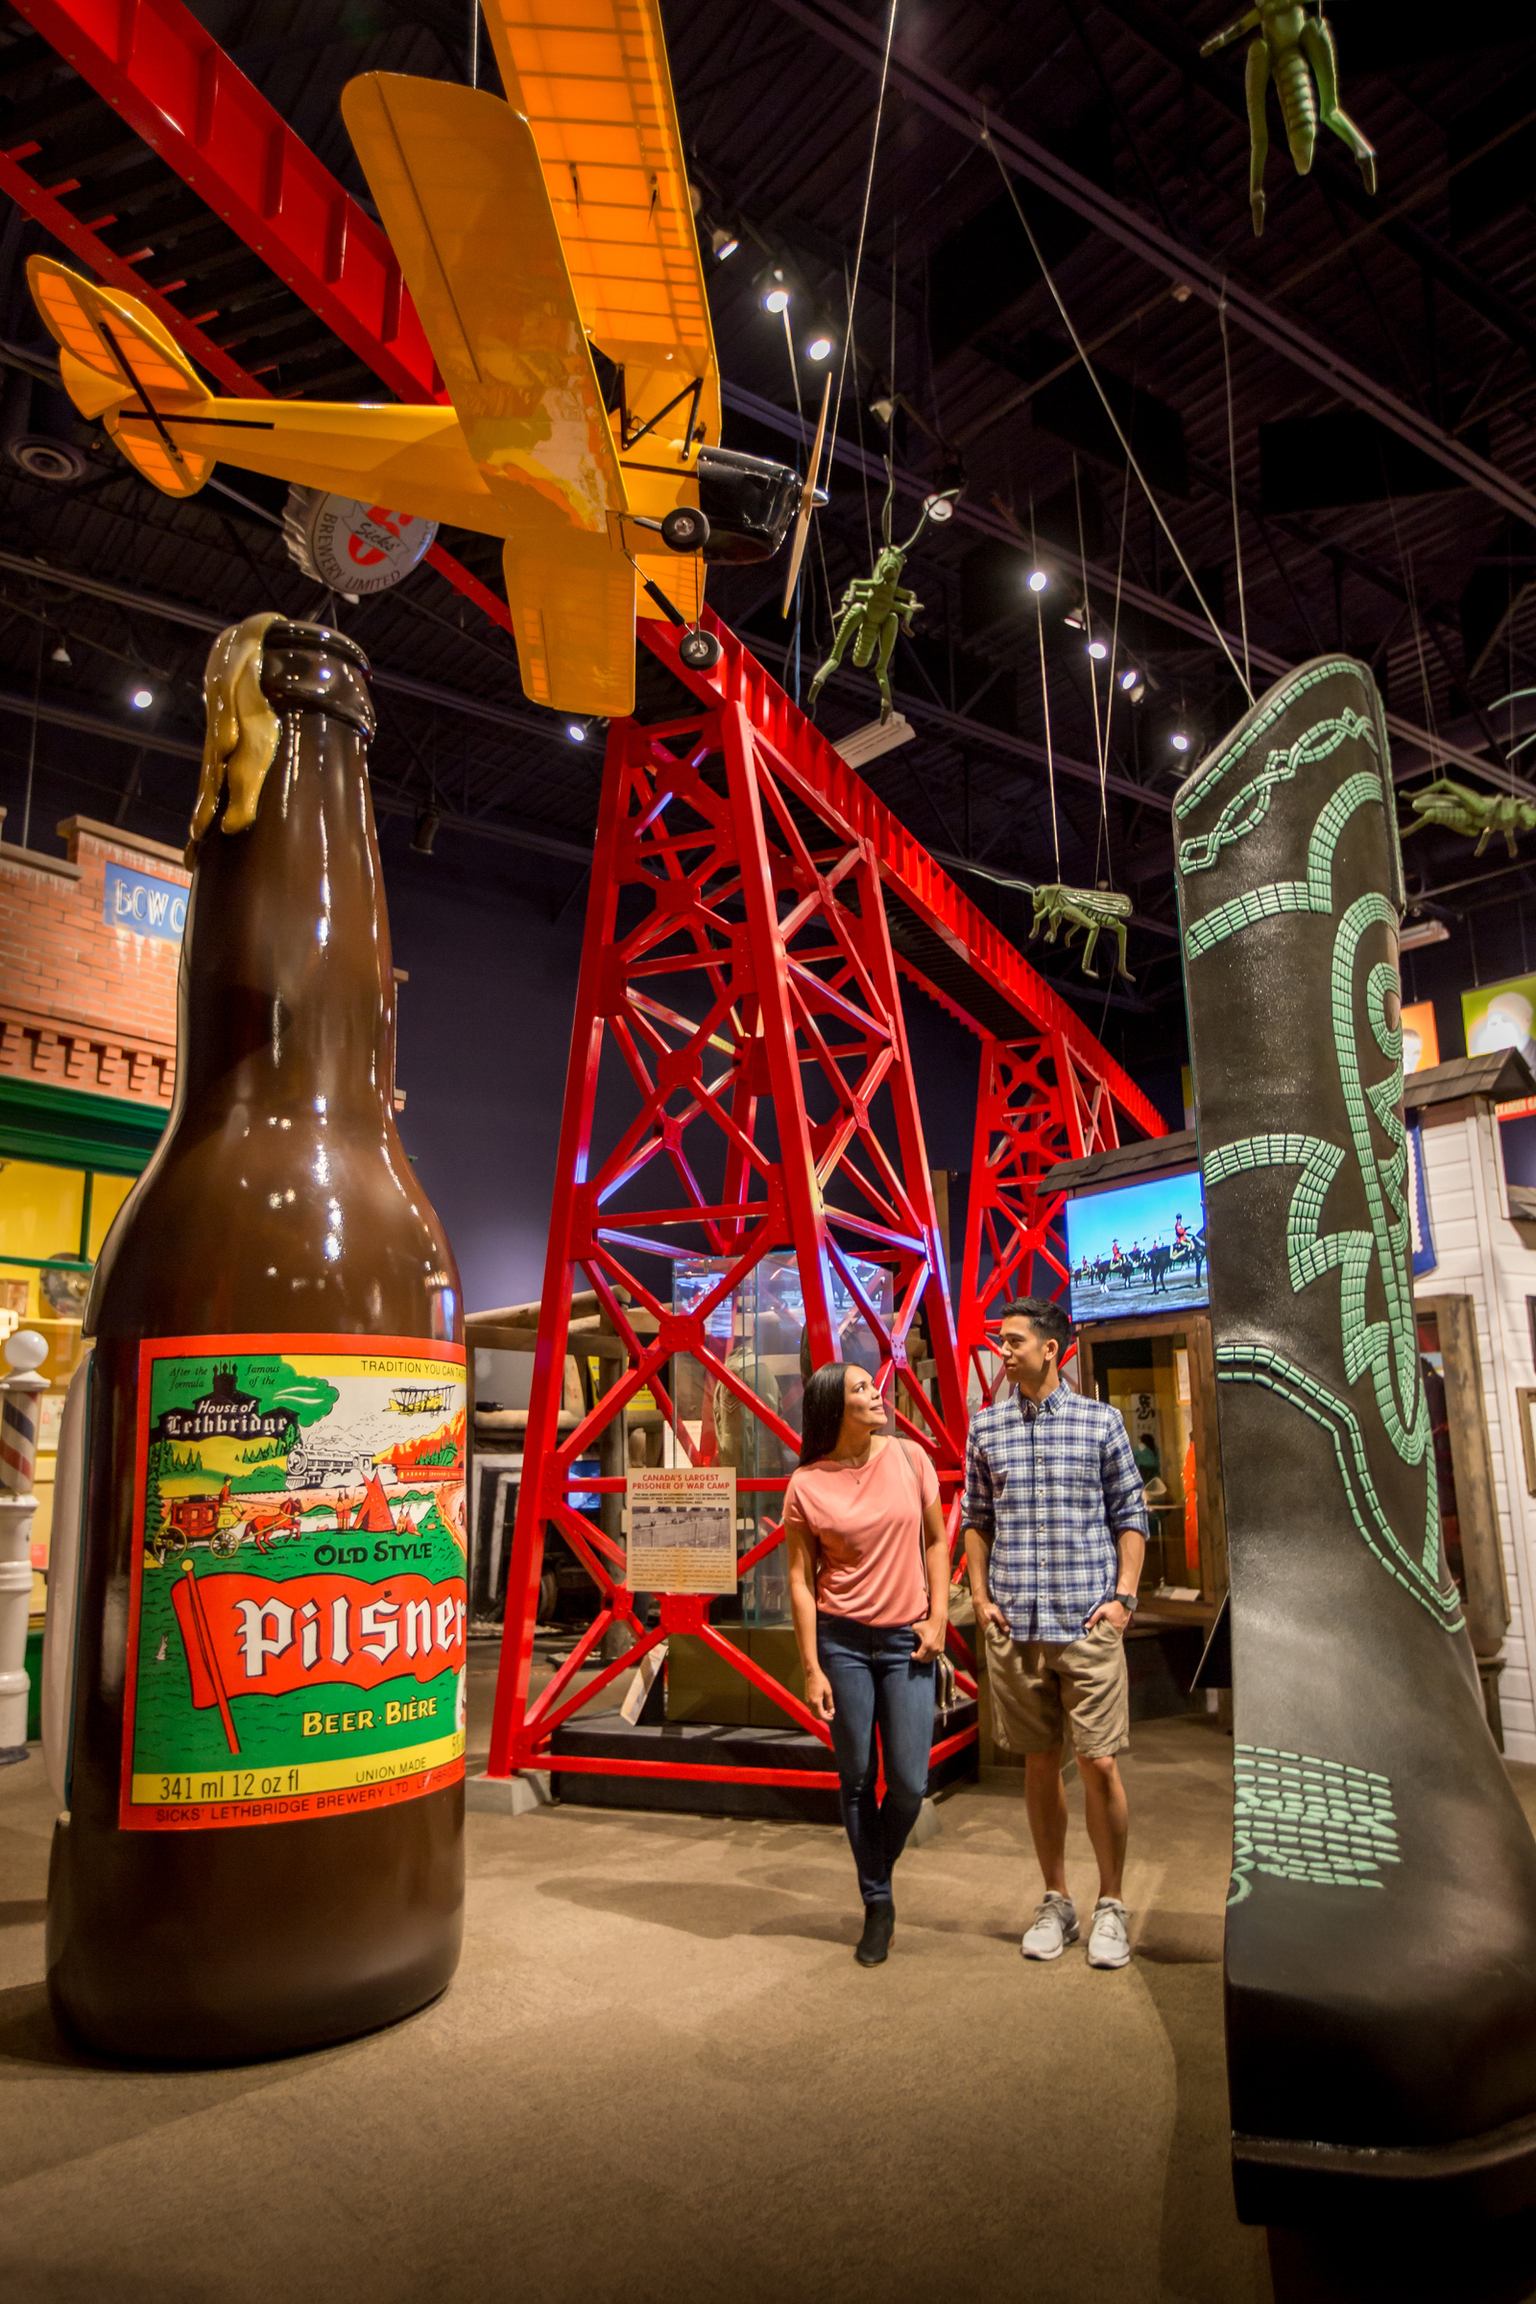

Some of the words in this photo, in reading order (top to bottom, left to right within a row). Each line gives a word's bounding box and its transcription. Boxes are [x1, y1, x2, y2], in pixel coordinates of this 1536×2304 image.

[318, 512, 345, 580] BREWERY
[345, 570, 401, 591] LIMITED
[169, 1367, 191, 1377] After
[195, 1366, 208, 1375] the
[245, 1363, 280, 1377] famous
[361, 1360, 421, 1373] TRADITION
[424, 1364, 440, 1375] YOU
[442, 1367, 455, 1377] CAN
[168, 1378, 204, 1391] formula
[249, 1376, 258, 1388] of
[262, 1376, 275, 1385] the
[240, 1400, 257, 1413] of
[167, 1413, 288, 1435] Lethbridge
[314, 1545, 368, 1567] OLD
[373, 1540, 433, 1563] STYLE
[233, 1594, 466, 1678] Pilsner
[355, 1765, 396, 1784] UNION
[400, 1756, 427, 1776] MADE
[160, 1776, 193, 1801] 341
[201, 1775, 224, 1800] ml
[233, 1773, 254, 1797] 12
[262, 1777, 281, 1793] oz
[288, 1768, 299, 1792] fl
[211, 1799, 310, 1820] LETHBRIDGE
[316, 1787, 383, 1809] BREWERY
